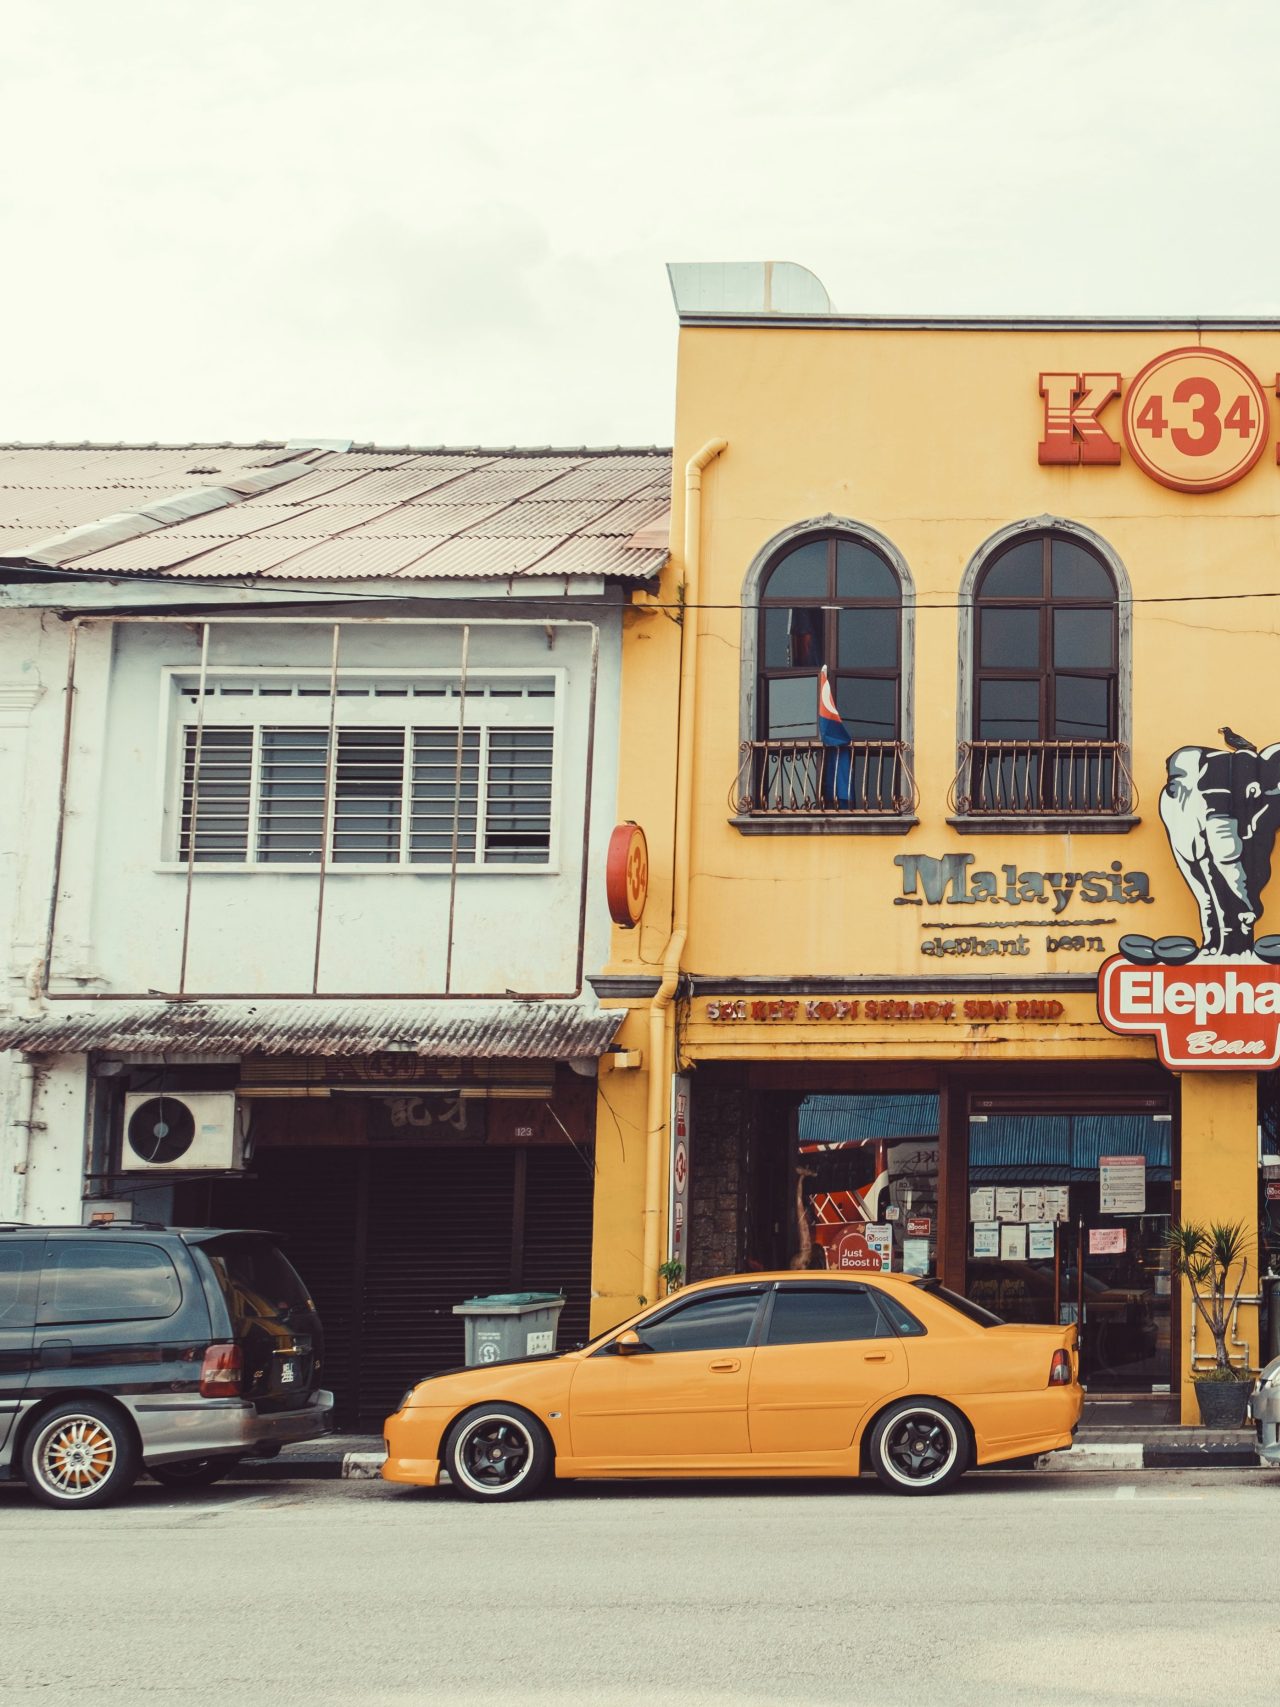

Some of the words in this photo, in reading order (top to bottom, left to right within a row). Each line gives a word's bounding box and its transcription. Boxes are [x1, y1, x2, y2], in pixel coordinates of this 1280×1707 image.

[1137, 377, 1256, 457] 434
[628, 846, 646, 900] 434
[893, 853, 1155, 914] Malaysia
[920, 933, 1031, 957] elephant
[1046, 934, 1106, 953] bean
[707, 1000, 747, 1020] SAI
[751, 1000, 799, 1021] KEE
[804, 1000, 860, 1021] KOPI
[963, 1000, 1010, 1020] SDN
[1015, 1000, 1065, 1020] BHD
[1186, 1031, 1267, 1055] Bean
[841, 1257, 870, 1267] Boost
[872, 1258, 880, 1267] It
[842, 1248, 862, 1257] Just
